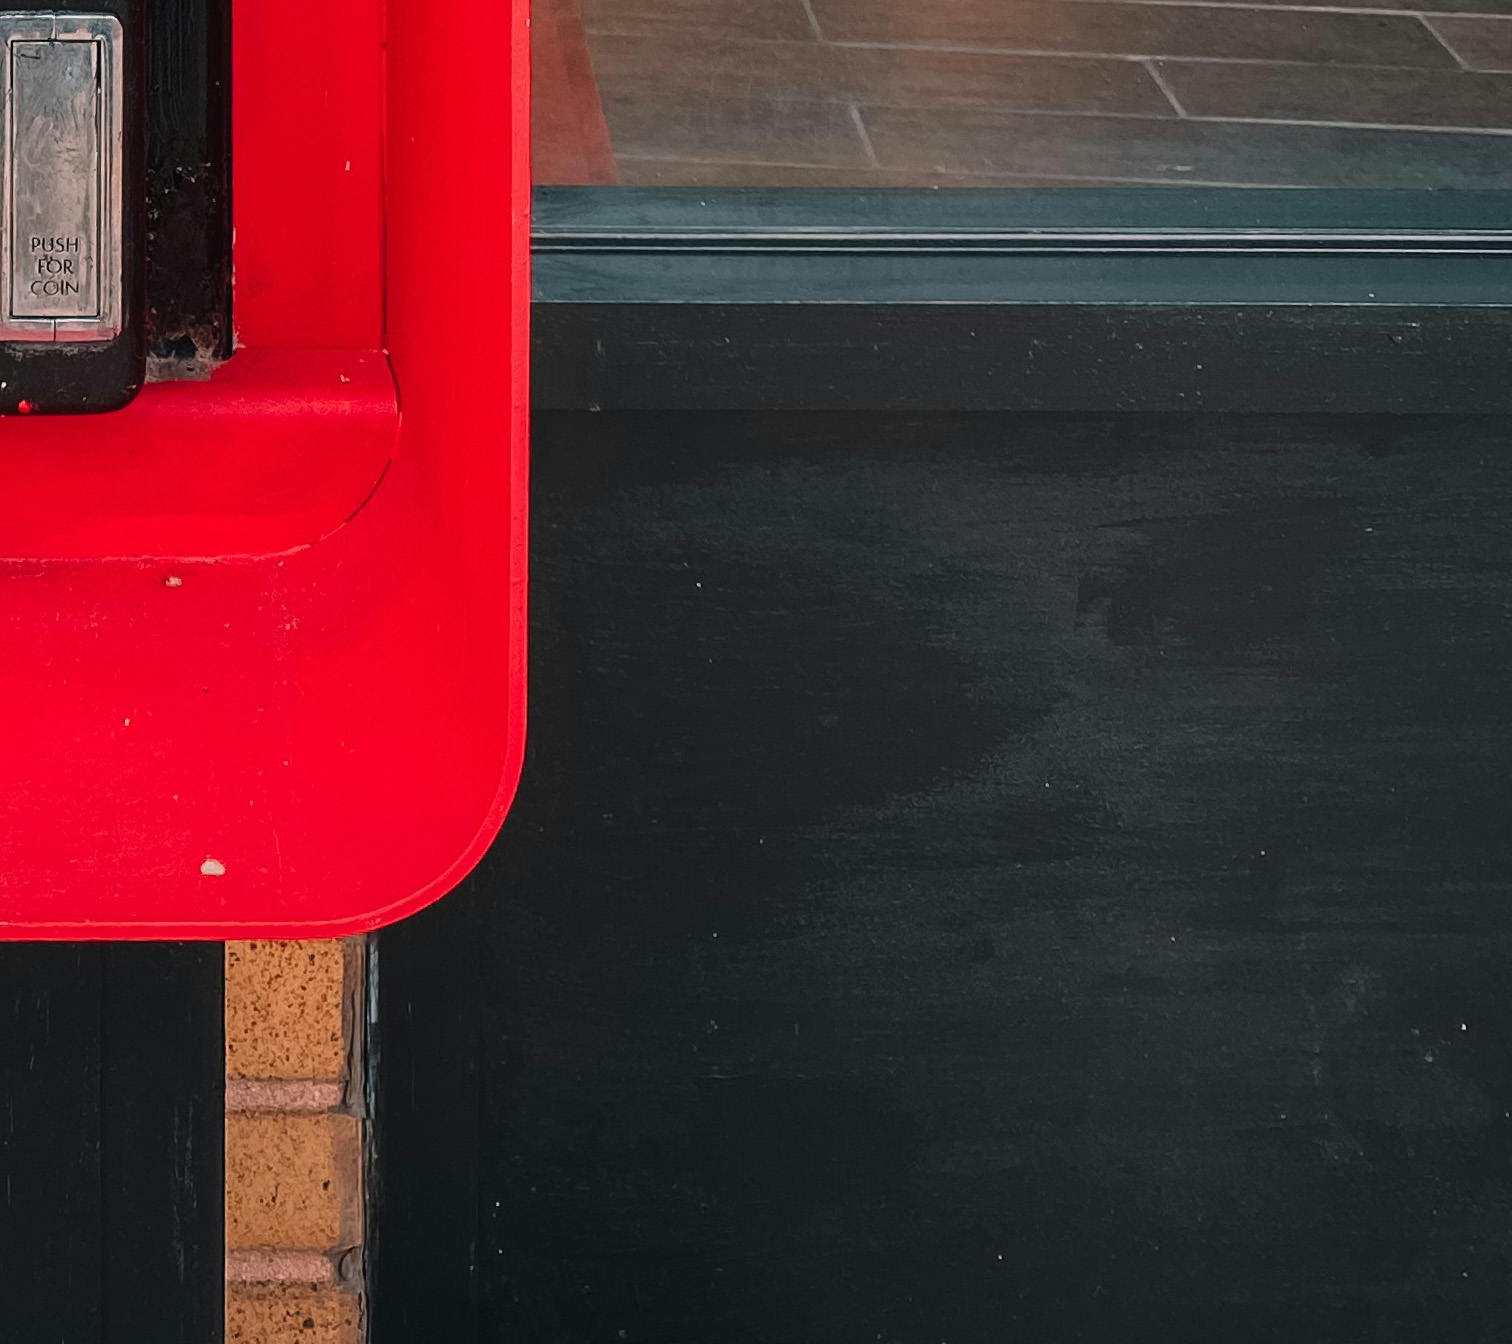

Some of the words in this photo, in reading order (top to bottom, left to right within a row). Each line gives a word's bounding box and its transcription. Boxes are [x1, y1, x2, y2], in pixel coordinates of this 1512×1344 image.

[31, 236, 79, 253] PUSH
[38, 258, 74, 275] FOR
[30, 279, 80, 296] COIN
